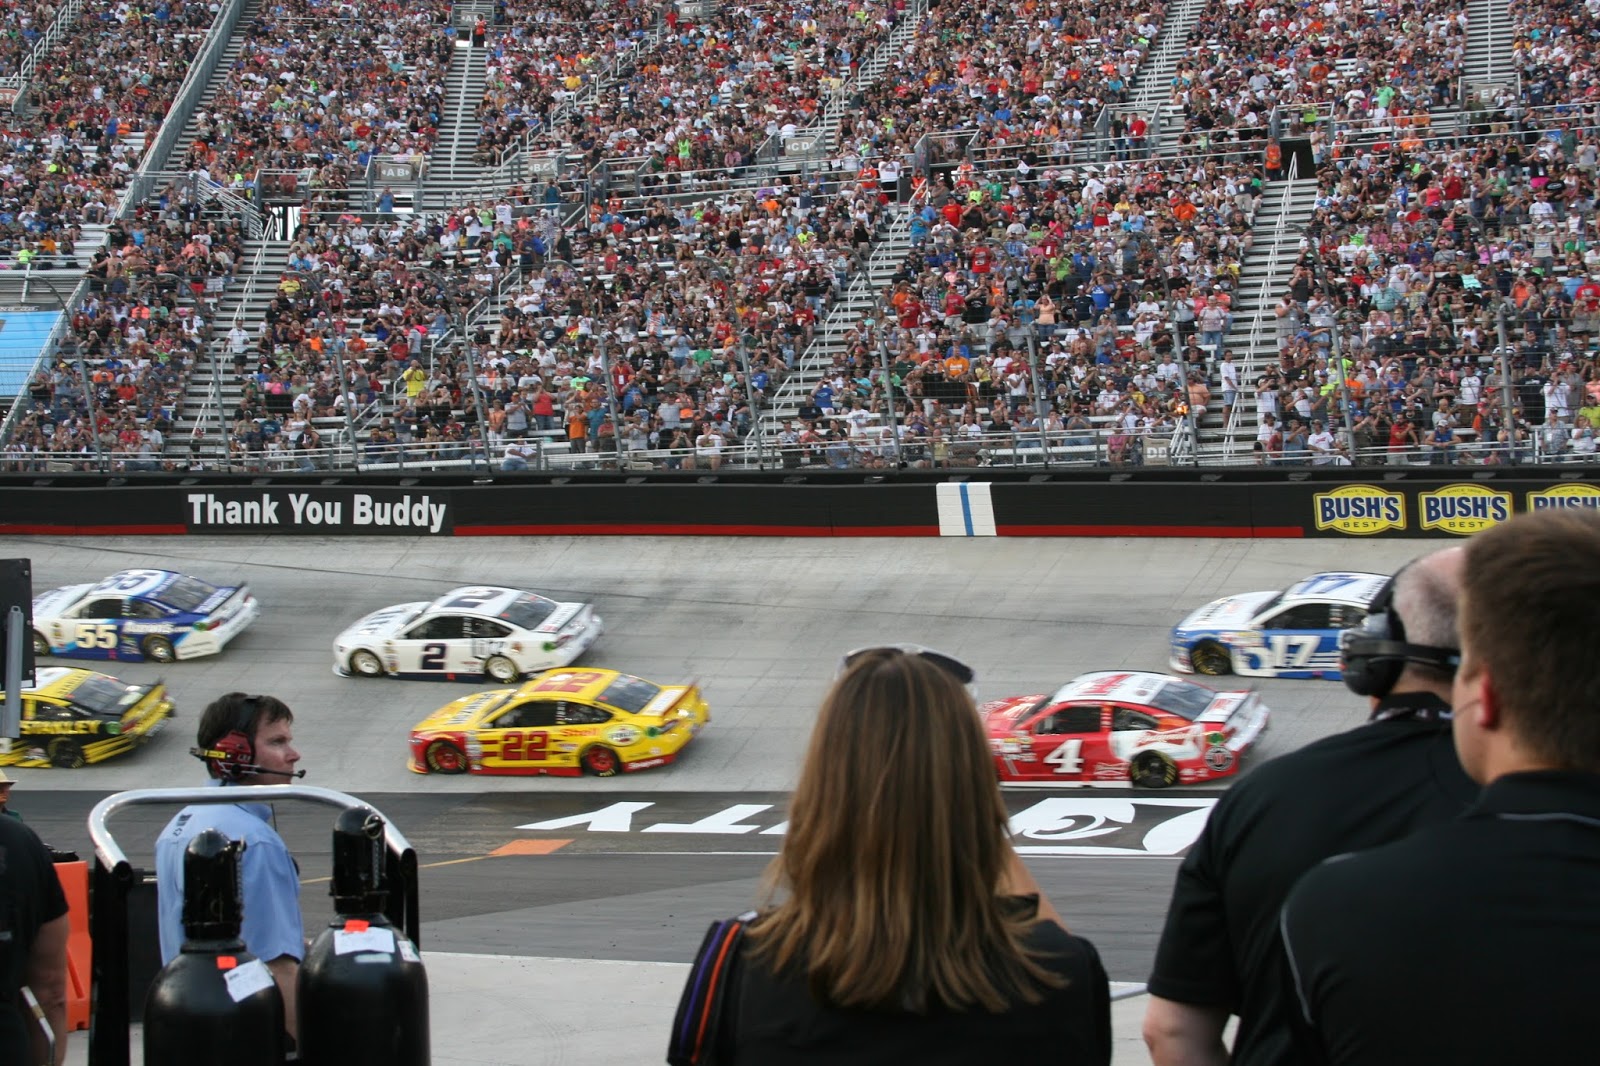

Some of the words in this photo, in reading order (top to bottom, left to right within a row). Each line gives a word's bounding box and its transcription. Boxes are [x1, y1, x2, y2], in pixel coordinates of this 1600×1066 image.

[188, 494, 279, 524] Thank
[288, 494, 341, 525] You
[353, 494, 446, 533] Buddy
[1320, 496, 1400, 523] BUSH'S
[1425, 496, 1507, 523] BUSH'S
[75, 624, 119, 649] 55
[420, 643, 447, 670] 2
[1270, 635, 1321, 668] 17
[502, 731, 548, 761] 22
[1042, 738, 1085, 774] 4
